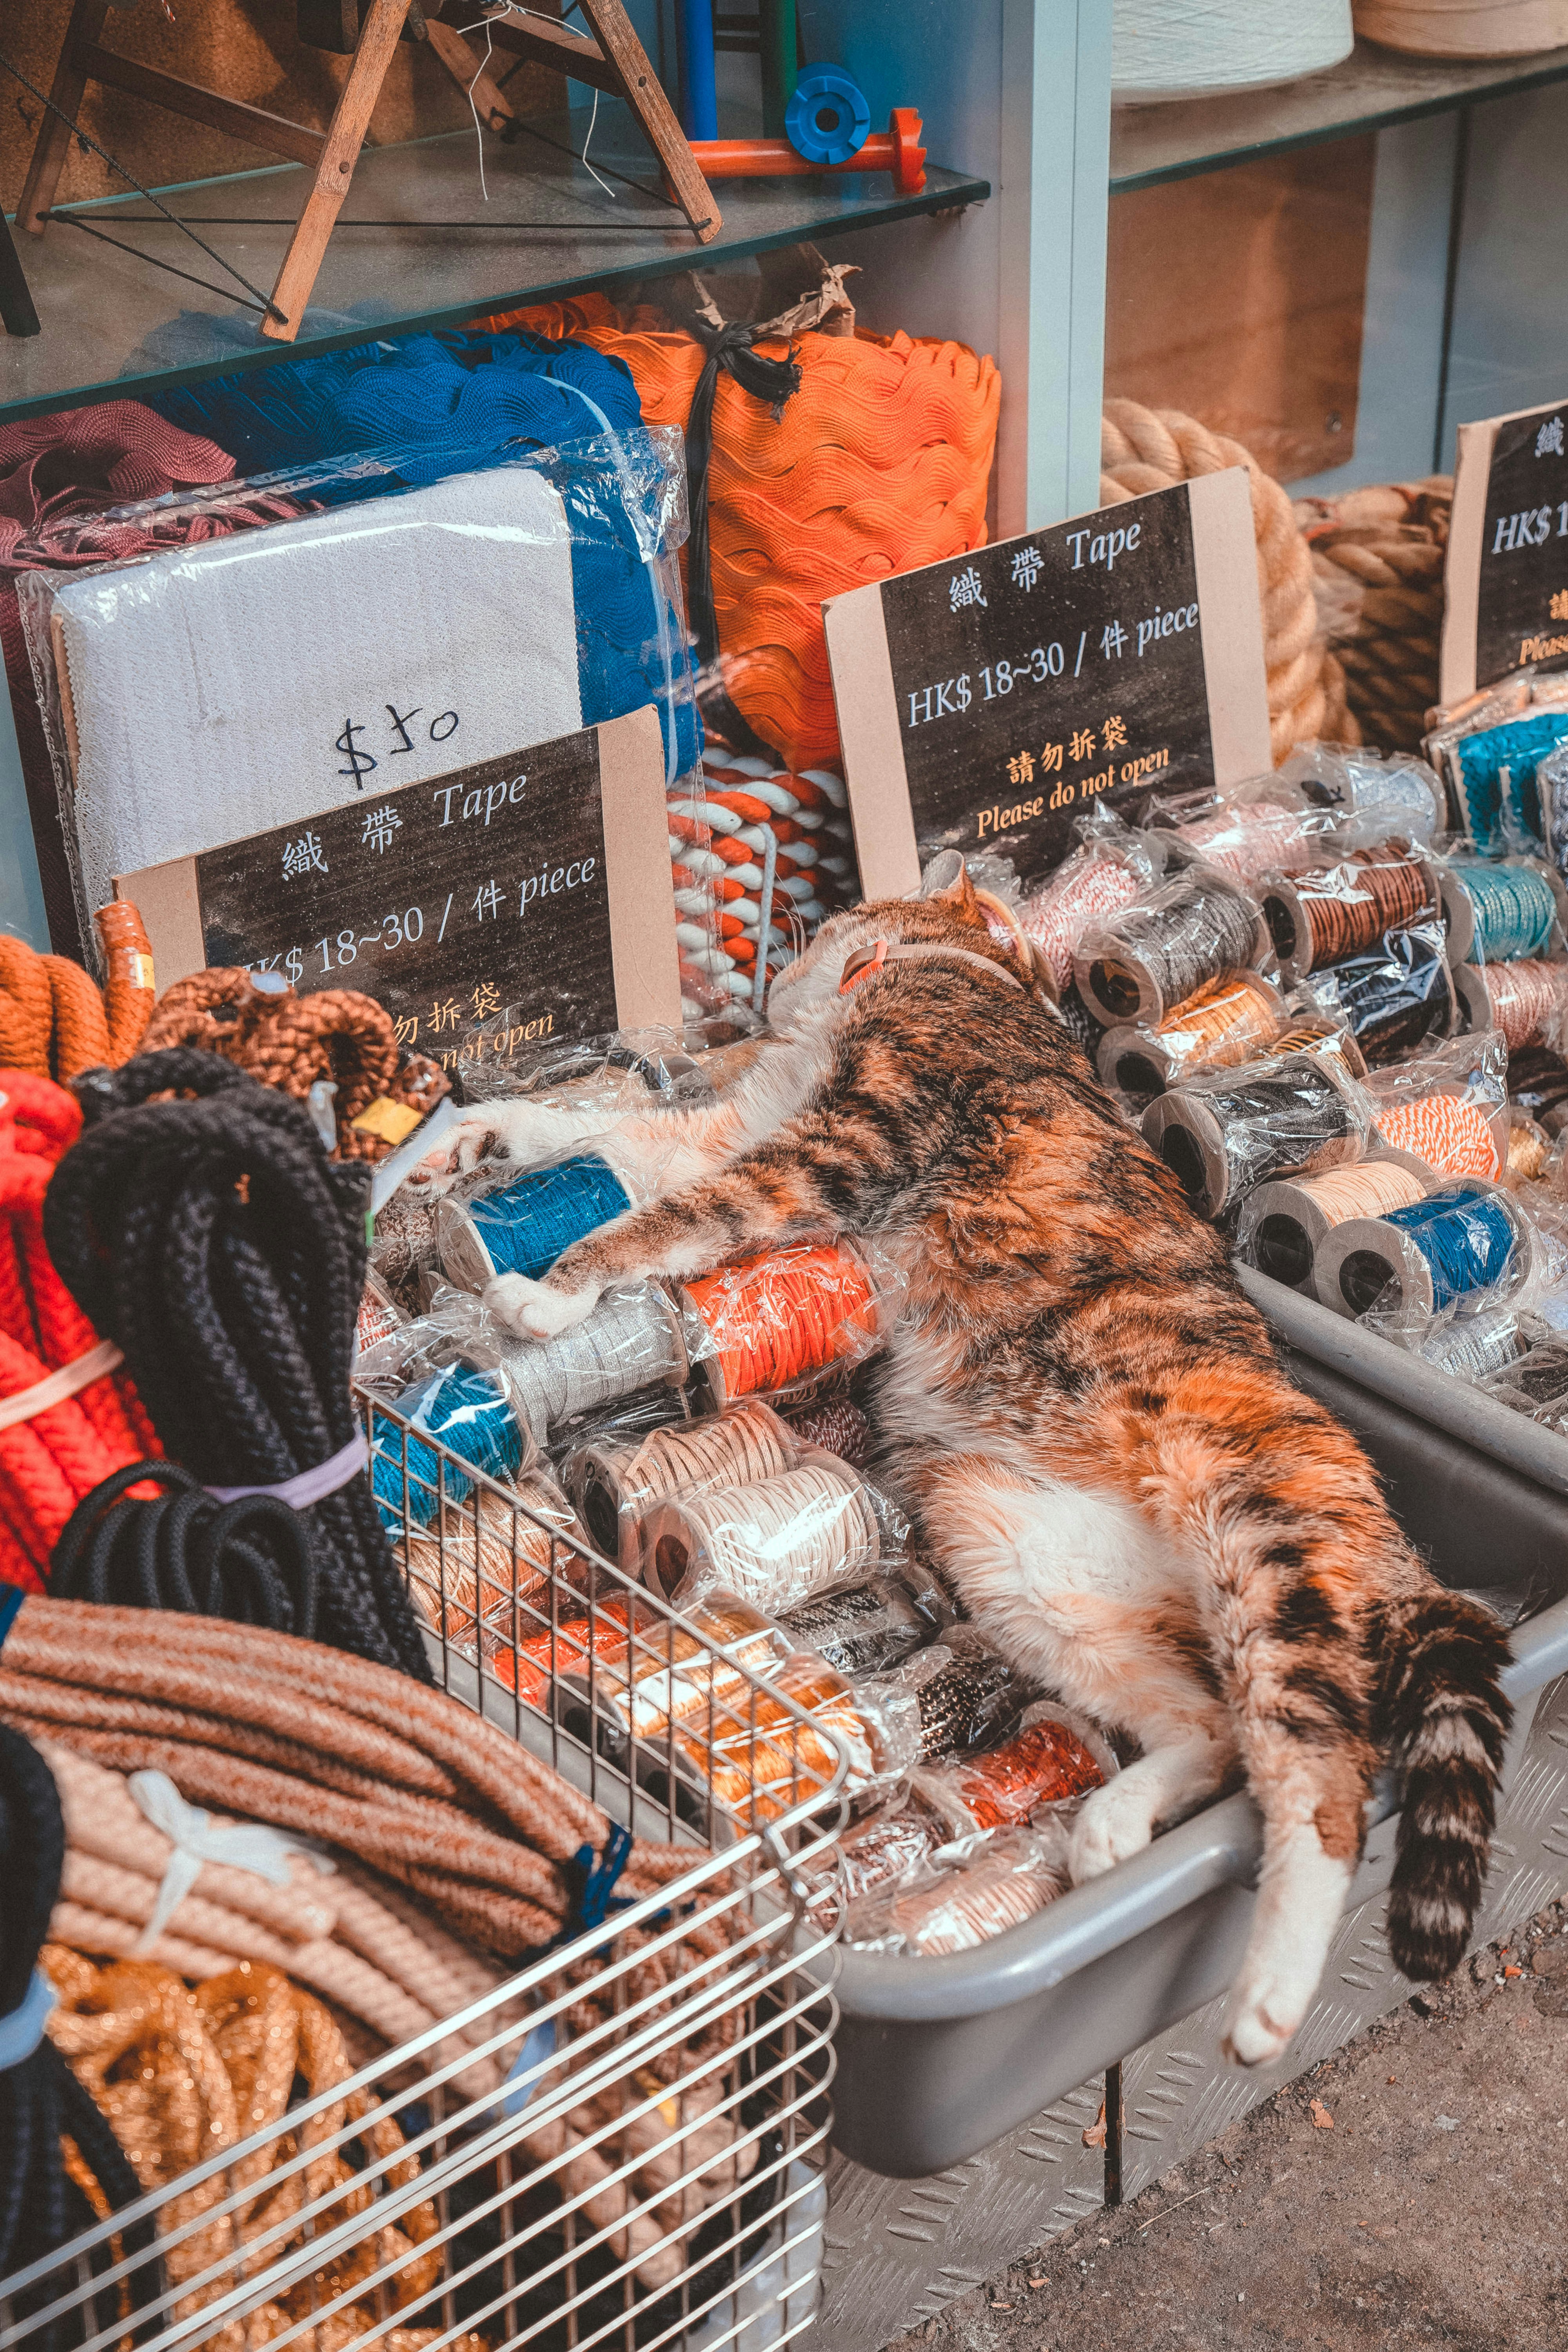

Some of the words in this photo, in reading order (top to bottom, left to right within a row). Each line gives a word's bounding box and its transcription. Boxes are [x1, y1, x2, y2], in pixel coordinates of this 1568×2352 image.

[948, 567, 988, 612] 織
[1011, 546, 1045, 592] 帶
[1066, 522, 1141, 571] Tape
[1491, 504, 1552, 554] HK$
[908, 673, 971, 727] HK$
[979, 642, 1064, 701] 18~30
[1074, 631, 1086, 677] /
[1100, 620, 1129, 660] 件
[1138, 603, 1199, 655] piece
[977, 796, 1043, 838] Please
[1049, 783, 1074, 808] do
[1082, 764, 1115, 797] not
[1121, 747, 1169, 785] open
[1006, 715, 1128, 785] 請勿拆袋
[281, 831, 328, 881] 織
[361, 806, 403, 855] 帶
[434, 774, 527, 827] Tape
[315, 907, 423, 973] 18~30
[438, 893, 453, 942] /
[471, 879, 506, 922] 件
[519, 857, 595, 916] piece
[441, 1035, 483, 1071] not
[494, 1013, 555, 1055] open
